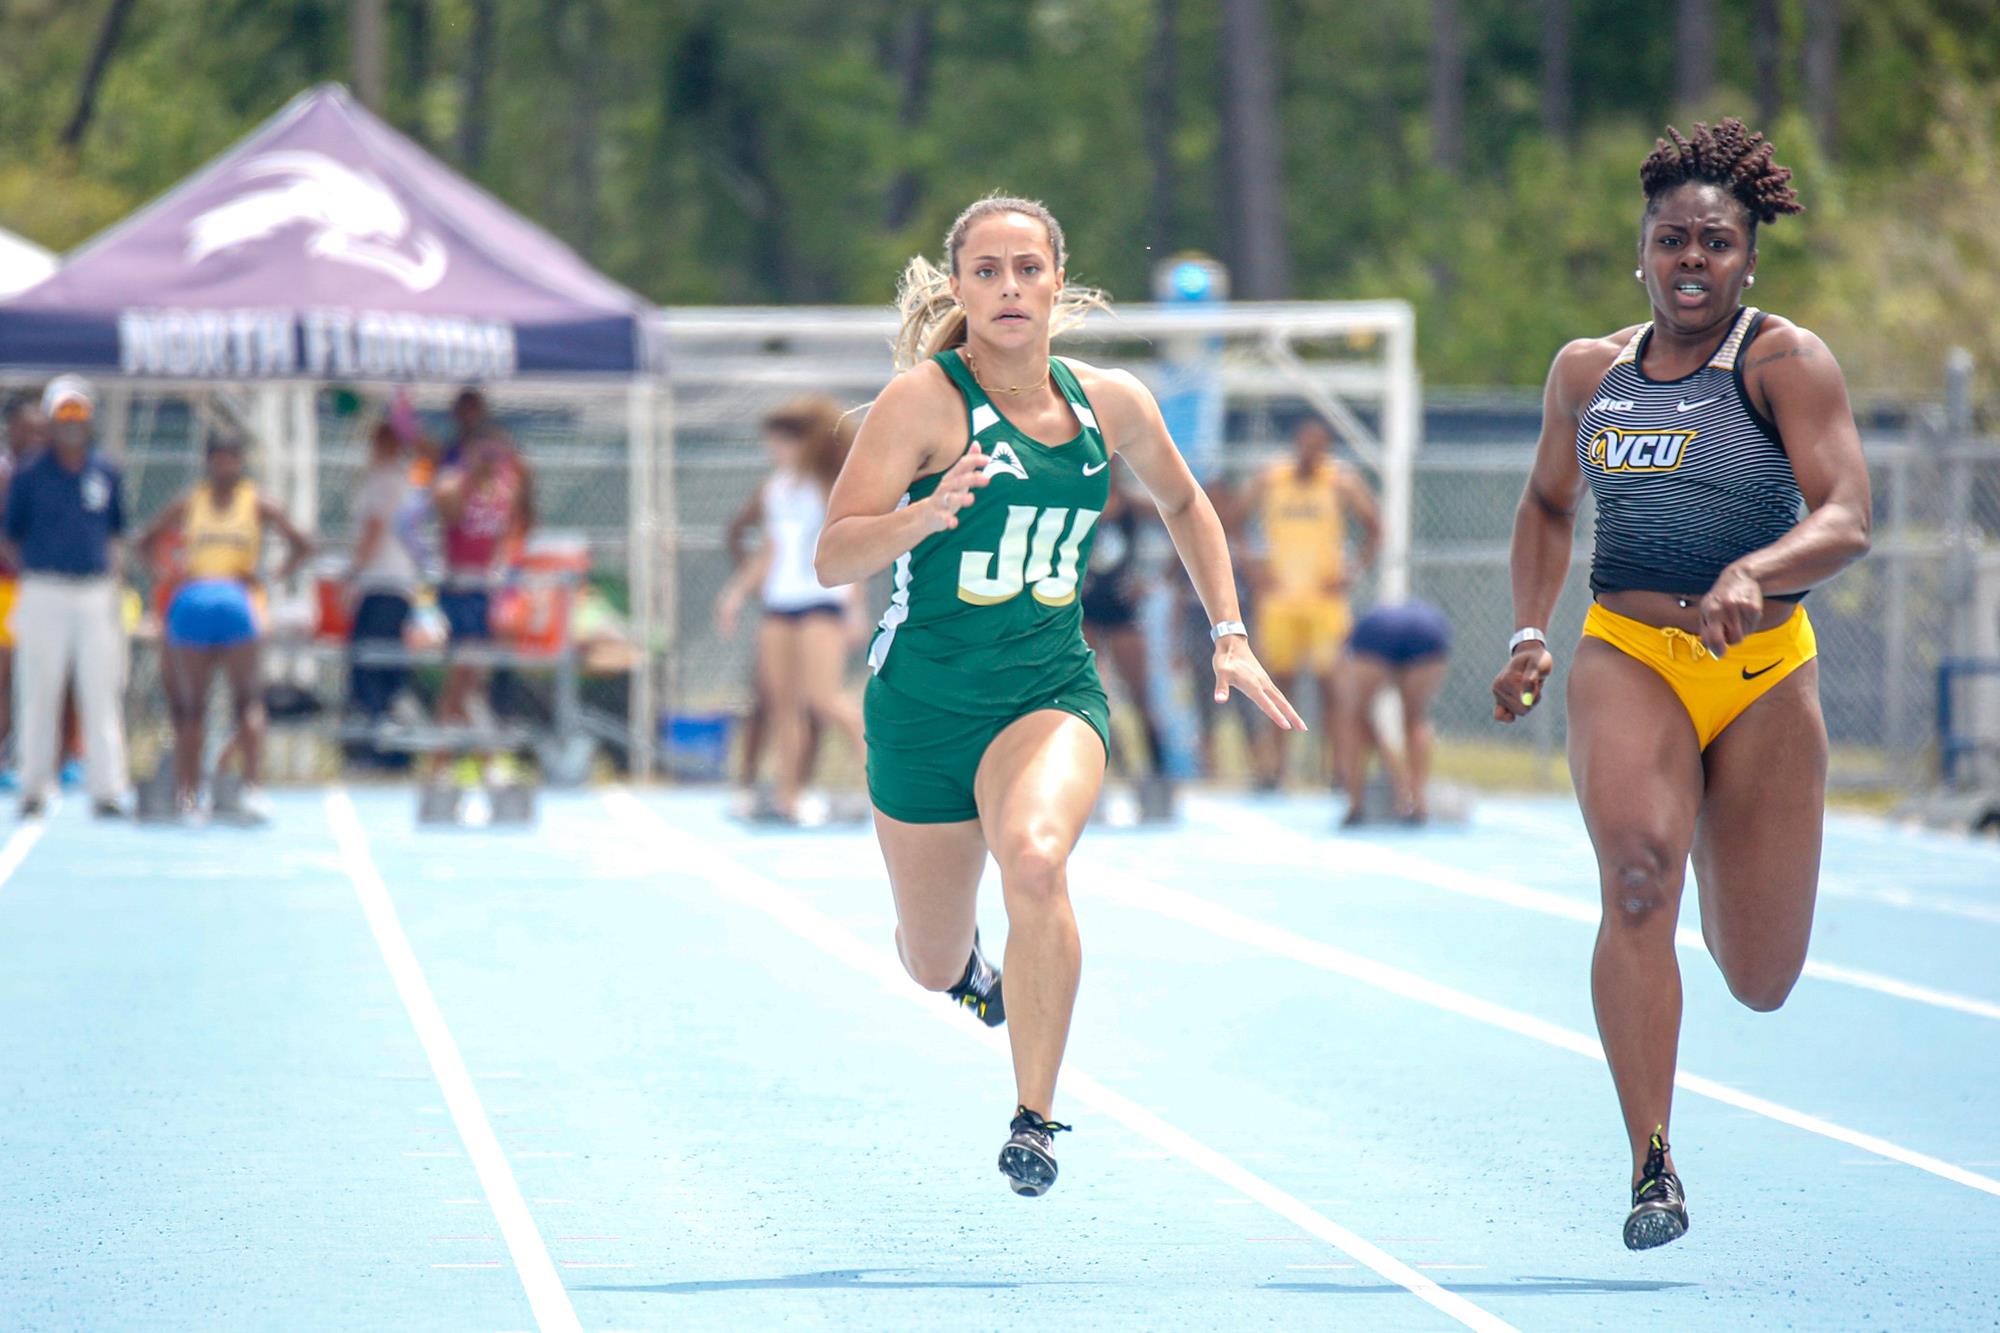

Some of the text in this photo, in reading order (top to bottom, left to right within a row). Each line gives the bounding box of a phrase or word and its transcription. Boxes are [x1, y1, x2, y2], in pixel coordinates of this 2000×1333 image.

[119, 309, 515, 377] NORTH FLORIDA
[1592, 429, 1692, 471] VCU
[957, 505, 1101, 608] JU
